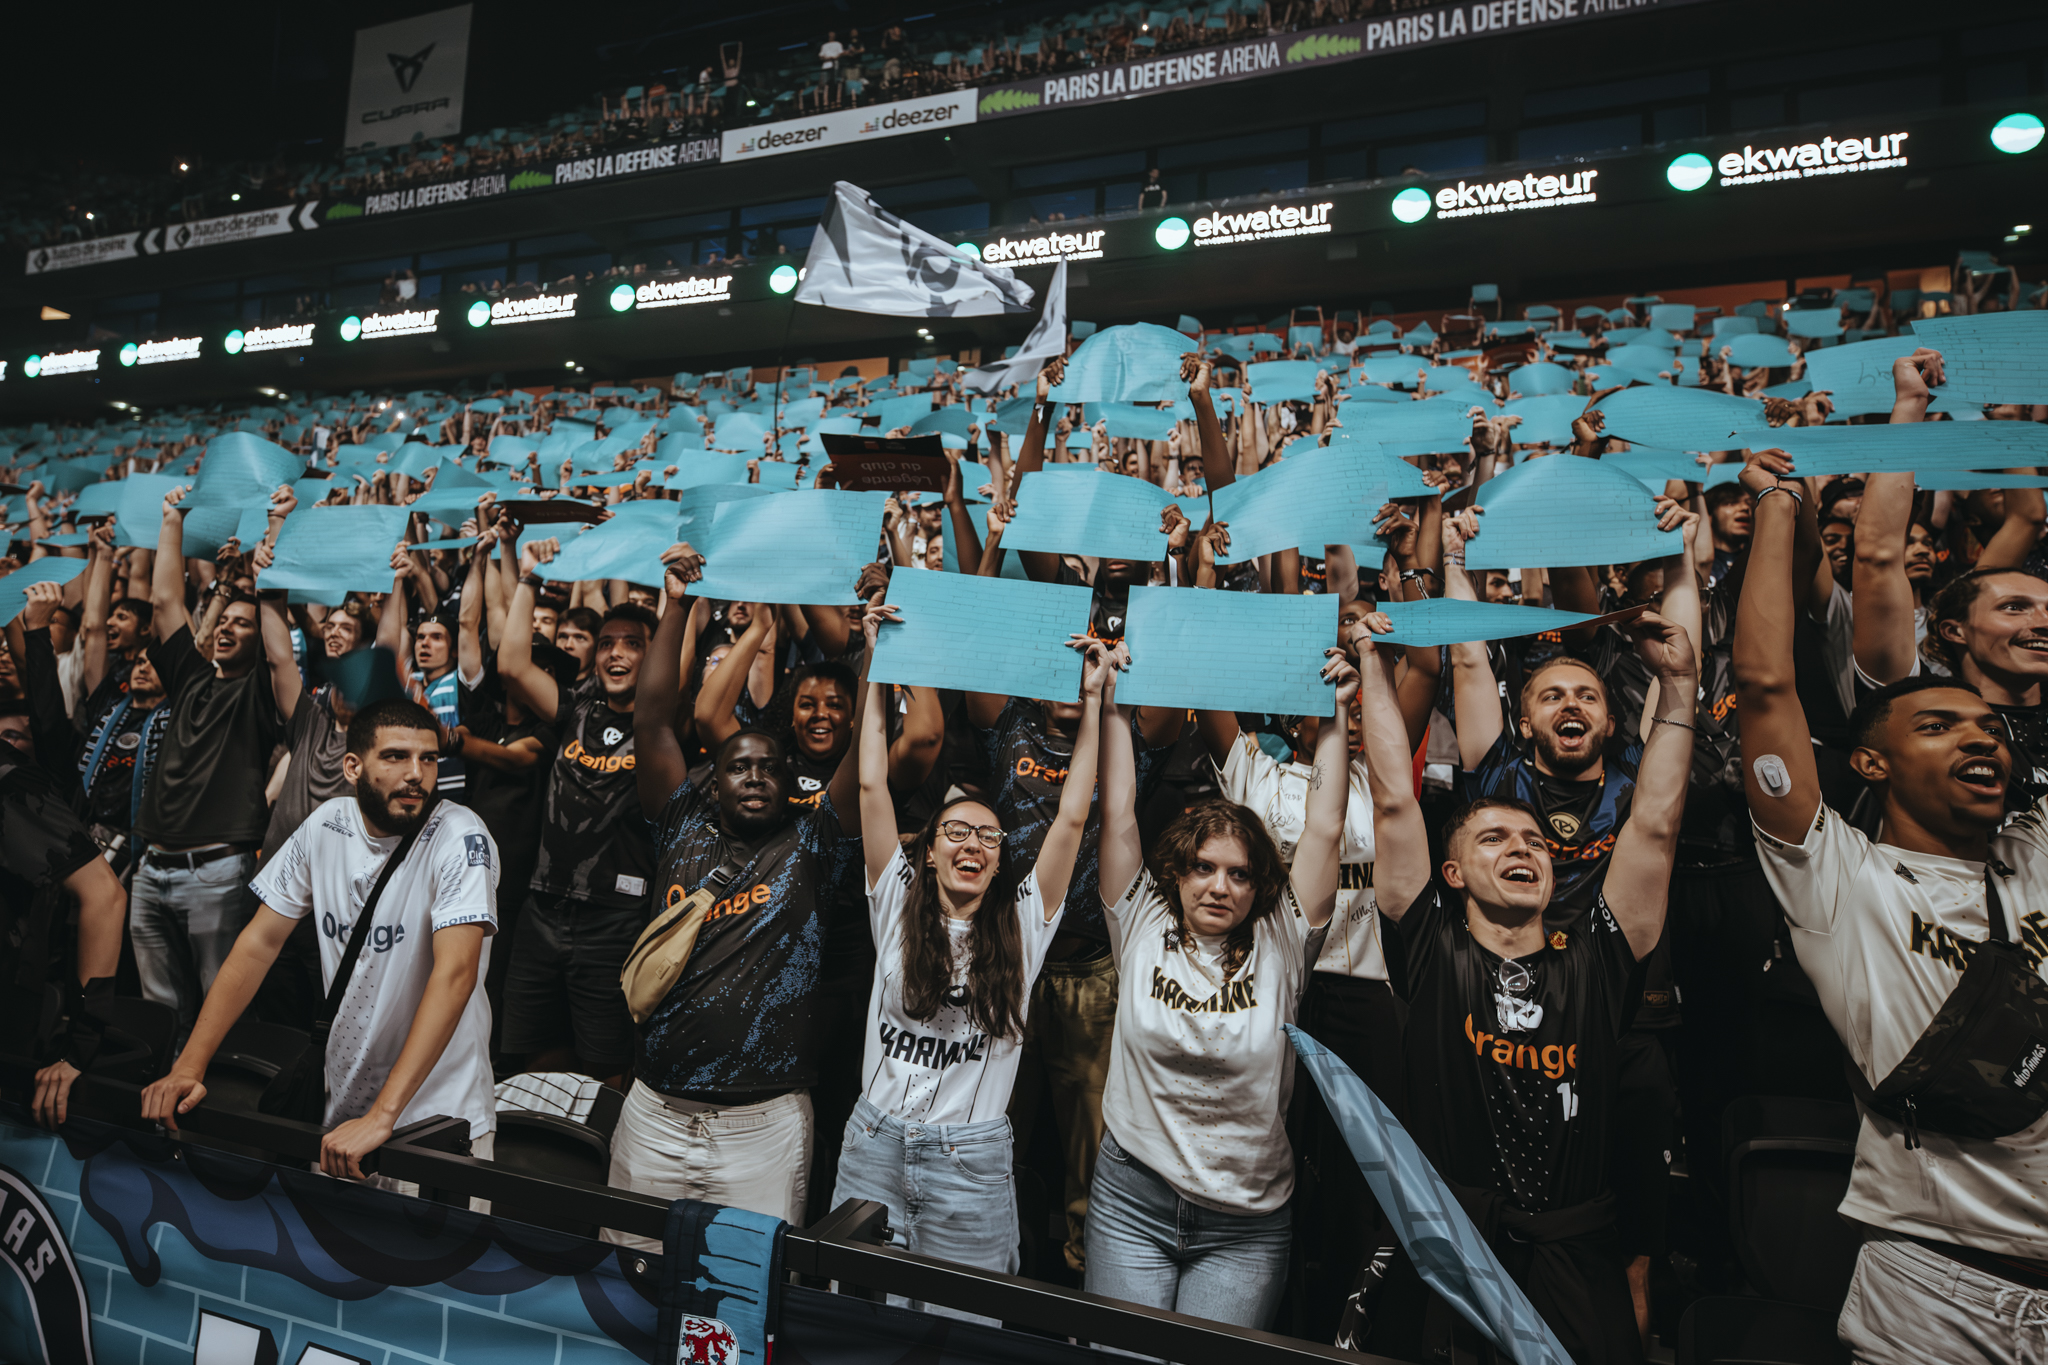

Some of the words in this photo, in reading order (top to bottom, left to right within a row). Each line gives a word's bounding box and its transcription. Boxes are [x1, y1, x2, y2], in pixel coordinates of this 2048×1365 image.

[1366, 13, 1434, 51] PARIS
[1438, 8, 1467, 39] LA
[1471, 0, 1579, 33] DEFENSE
[1044, 72, 1100, 105] PARIS
[1102, 68, 1127, 96] LA
[1130, 52, 1217, 91] DEFENSE
[1219, 41, 1281, 76] ARENA
[362, 97, 451, 124] CUPRA
[882, 104, 959, 130] deezer
[757, 125, 828, 150] deezer
[1718, 132, 1909, 177] ekwateur
[555, 157, 595, 185] PARIS
[596, 154, 615, 178] LA
[615, 144, 678, 174] DEFENSE
[678, 137, 721, 166] ARENA
[365, 190, 401, 216] PARIS
[401, 186, 416, 211] LA
[416, 179, 469, 207] DEFENSE
[1435, 170, 1599, 210] ekwateur
[1193, 202, 1334, 238] ekwateur
[982, 228, 1105, 263] ekwateur
[491, 292, 578, 318] ekwateur
[636, 274, 733, 303] ekwateur
[361, 308, 439, 334] ekwateur
[861, 461, 896, 472] club
[861, 473, 933, 486] Légende
[901, 462, 921, 472] du
[564, 739, 637, 773] Orange
[666, 883, 771, 923] Onge
[322, 911, 405, 954] Orge
